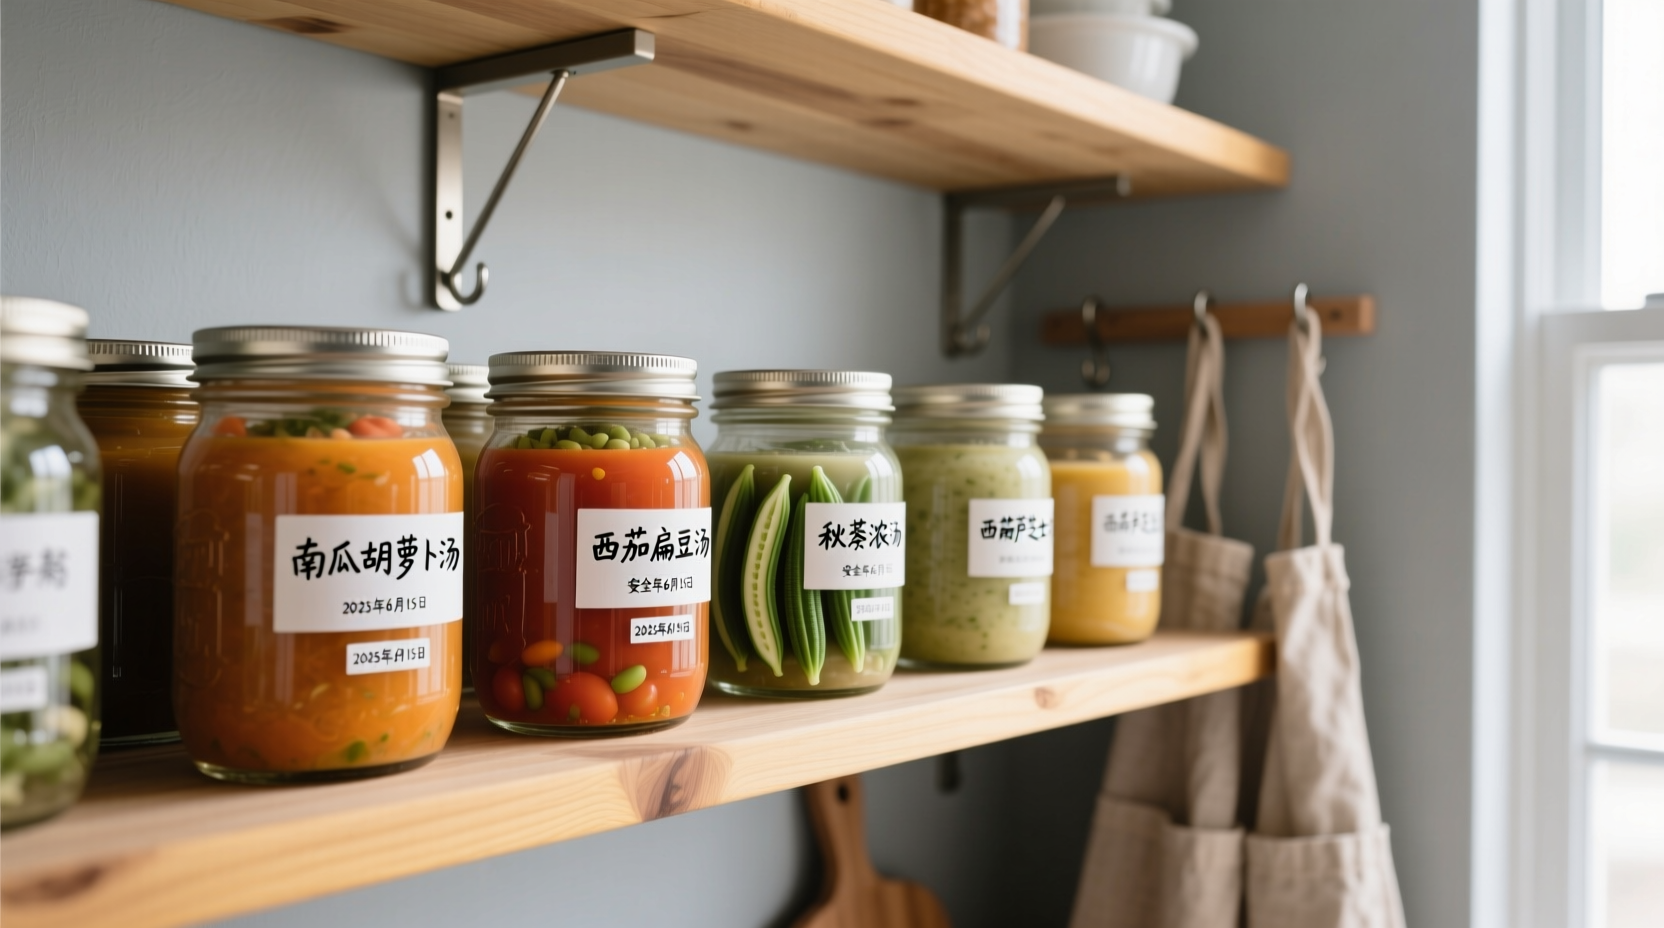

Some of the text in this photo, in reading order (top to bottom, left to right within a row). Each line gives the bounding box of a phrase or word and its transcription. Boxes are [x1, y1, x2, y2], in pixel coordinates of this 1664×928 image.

[291, 533, 461, 581] 南瓜胡萝卜汤
[592, 526, 710, 564] 西茄扁豆汤
[342, 596, 427, 615] 2025年6月15日
